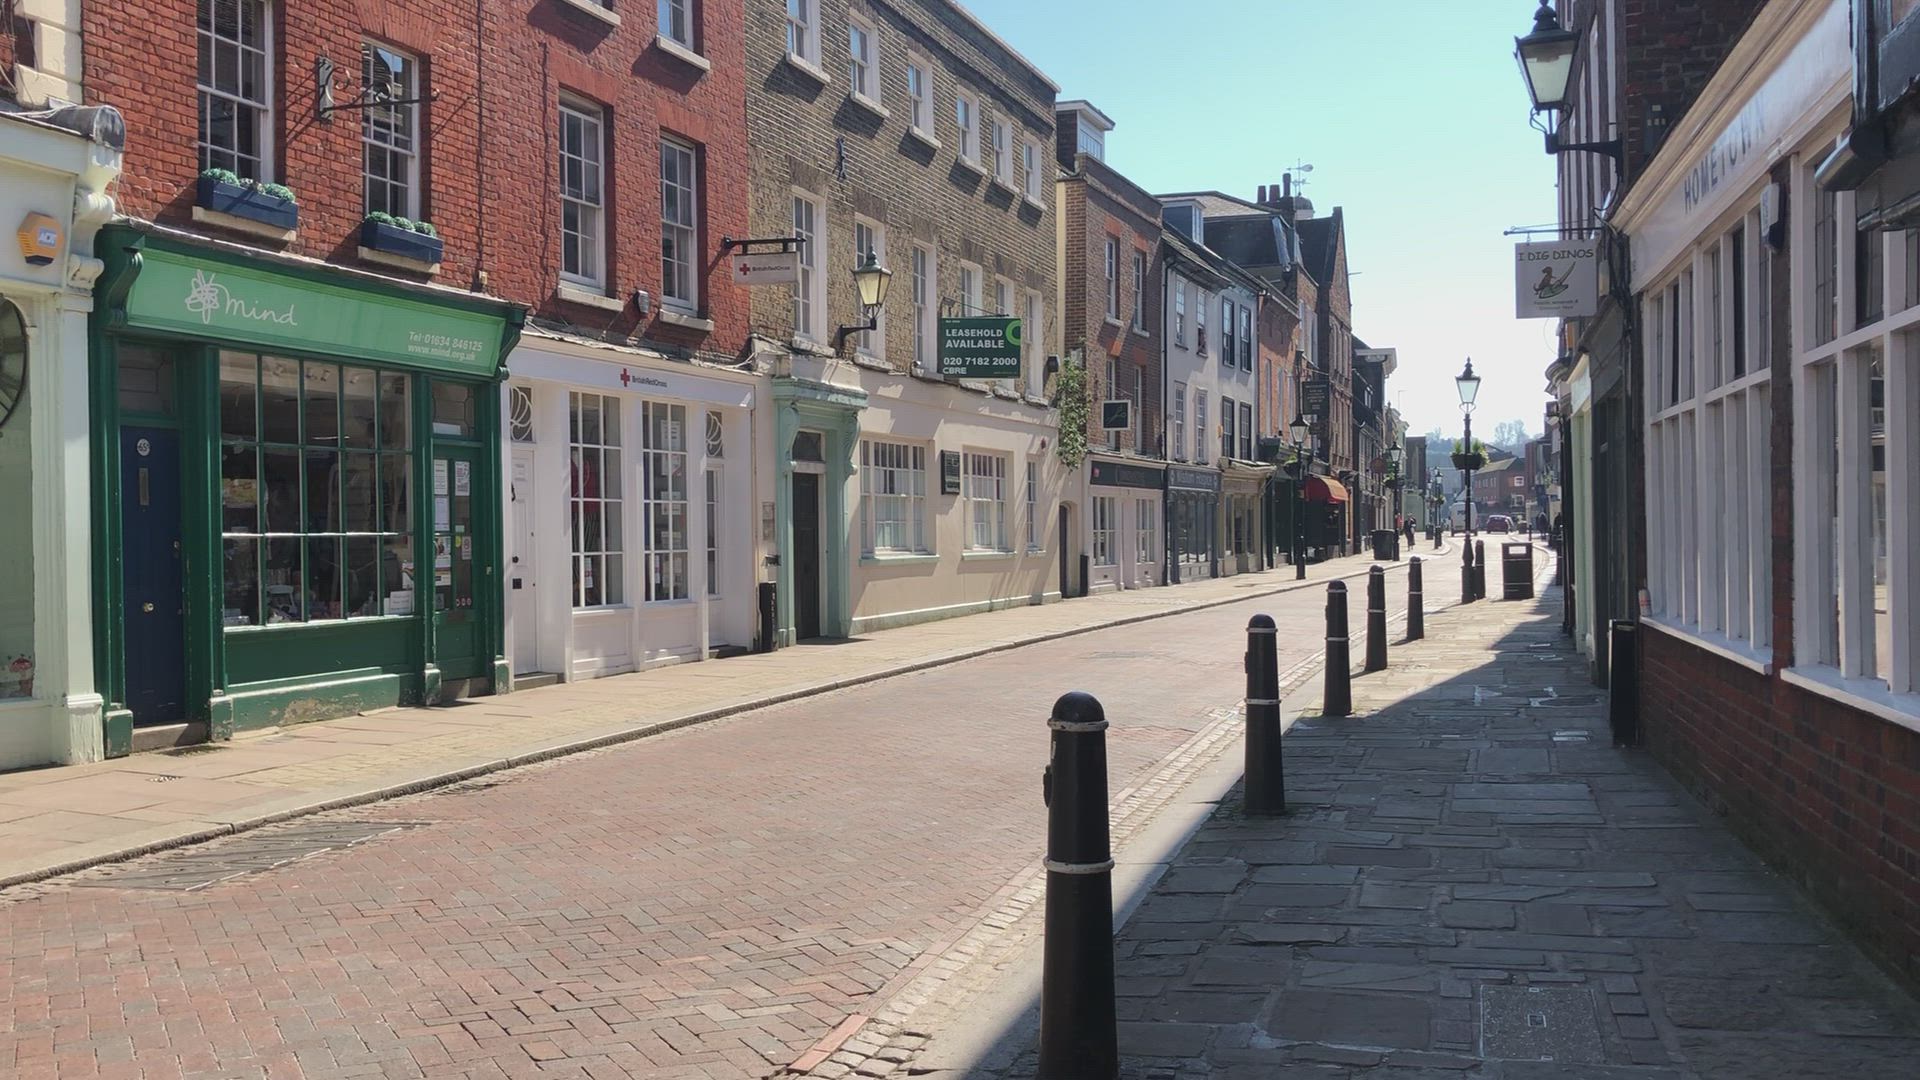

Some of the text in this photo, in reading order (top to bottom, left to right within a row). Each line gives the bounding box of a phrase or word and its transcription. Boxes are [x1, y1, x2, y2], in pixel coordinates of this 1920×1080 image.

[1518, 248, 1595, 261] I DIG DINOS
[945, 328, 1003, 337] LEASEHOLD
[945, 339, 1005, 348] AVAILABLE
[943, 357, 1017, 366] 020 7182 2000
[942, 366, 967, 375] CBRE
